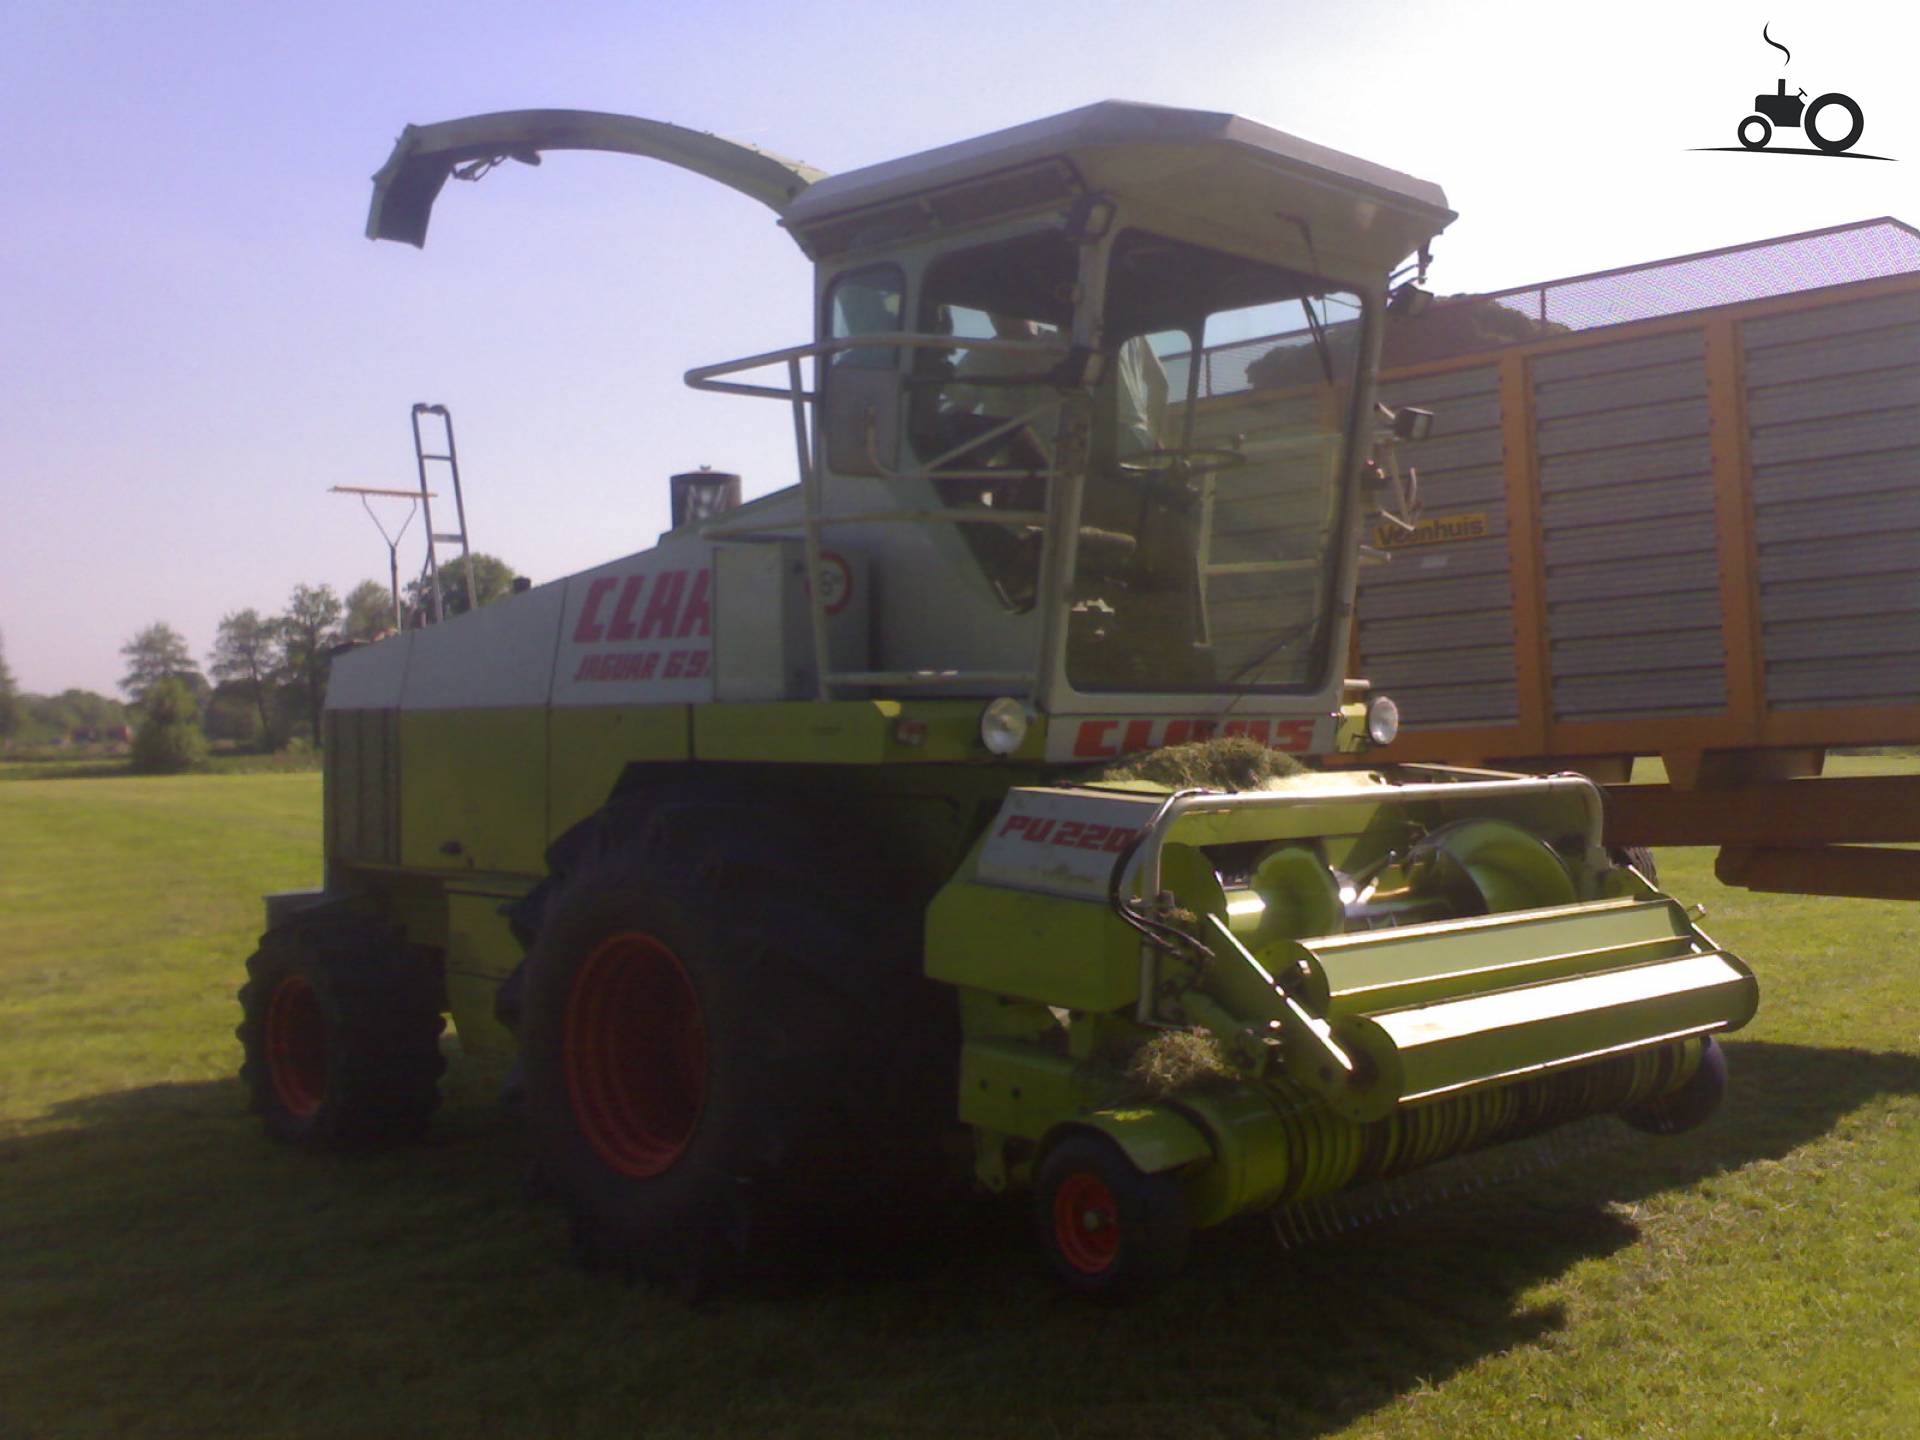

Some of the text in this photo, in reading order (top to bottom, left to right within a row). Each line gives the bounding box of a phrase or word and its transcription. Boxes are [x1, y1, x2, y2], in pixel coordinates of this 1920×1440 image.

[574, 569, 711, 642] CLAA
[575, 650, 711, 681] JAGUAR 69
[998, 815, 1140, 853] PU 220
